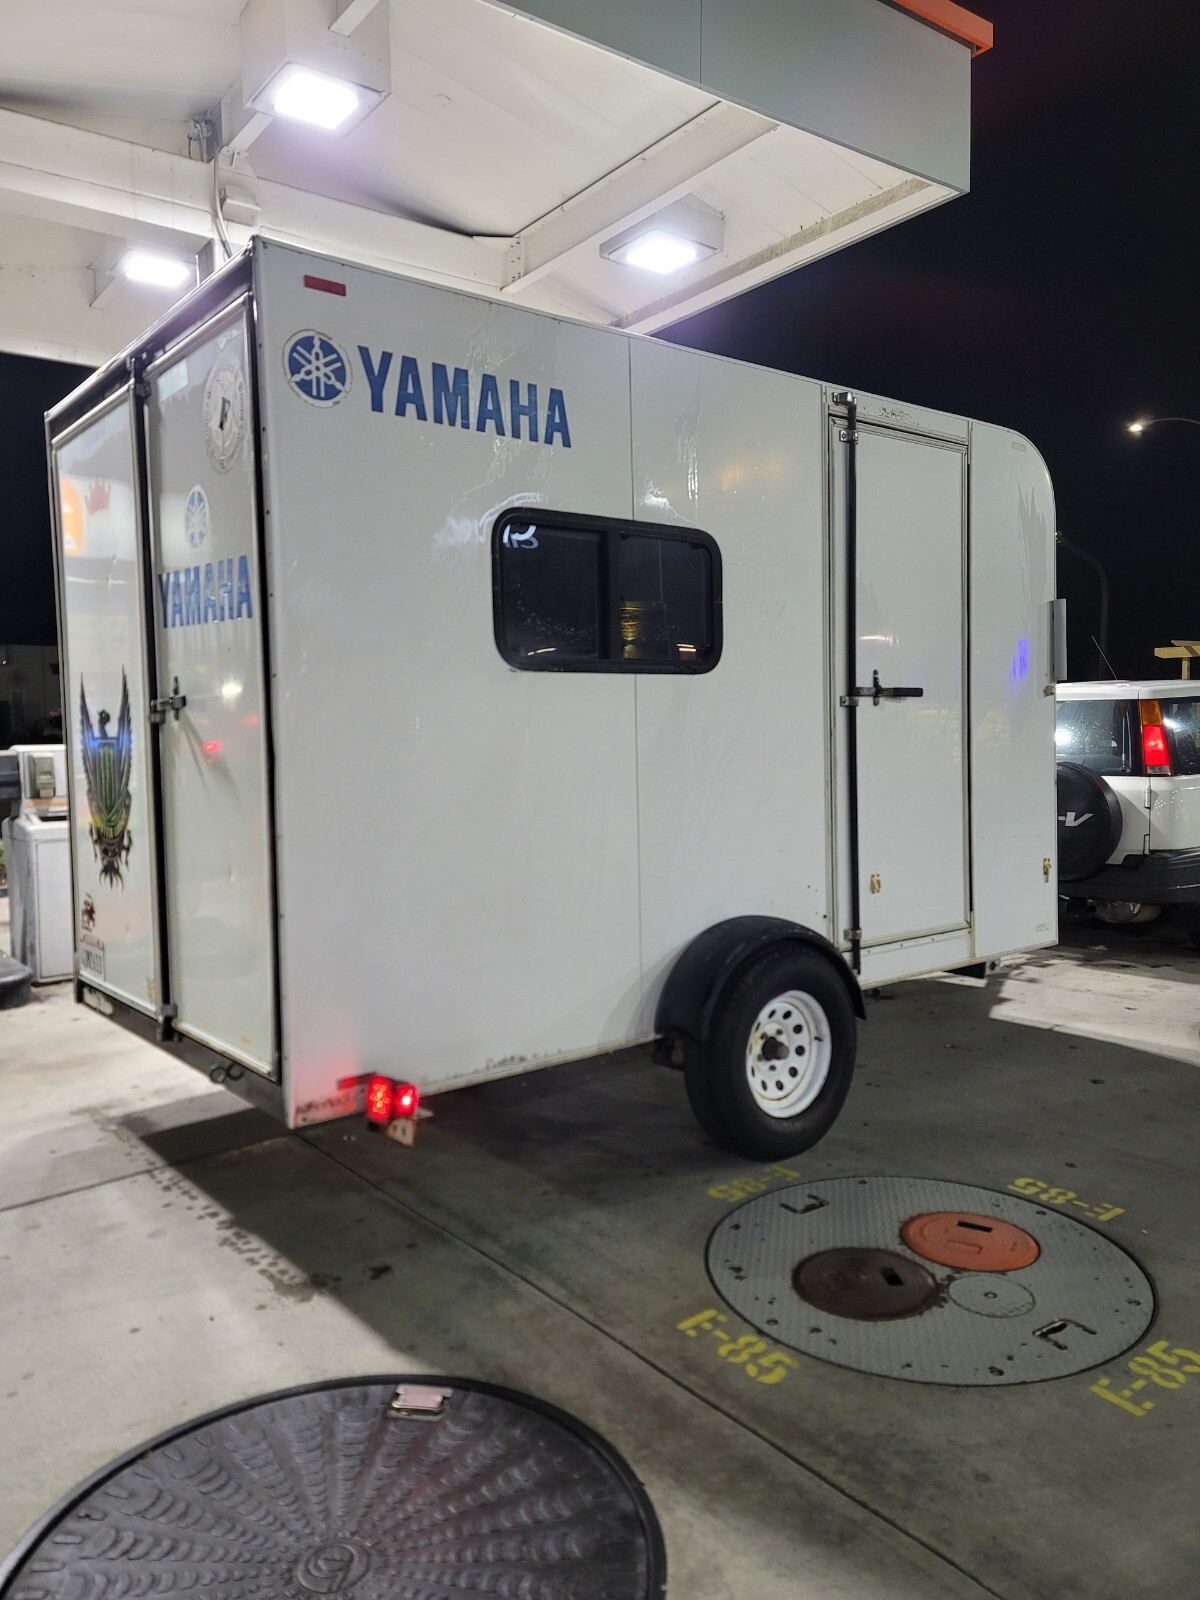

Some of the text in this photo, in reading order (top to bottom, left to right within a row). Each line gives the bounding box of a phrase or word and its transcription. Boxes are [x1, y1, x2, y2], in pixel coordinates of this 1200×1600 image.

[357, 345, 572, 449] YAMAHA
[158, 555, 253, 629] YAMAHA
[1006, 1178, 1125, 1221] E-85
[676, 1308, 799, 1385] E-85
[1090, 1340, 1200, 1417] E-85
